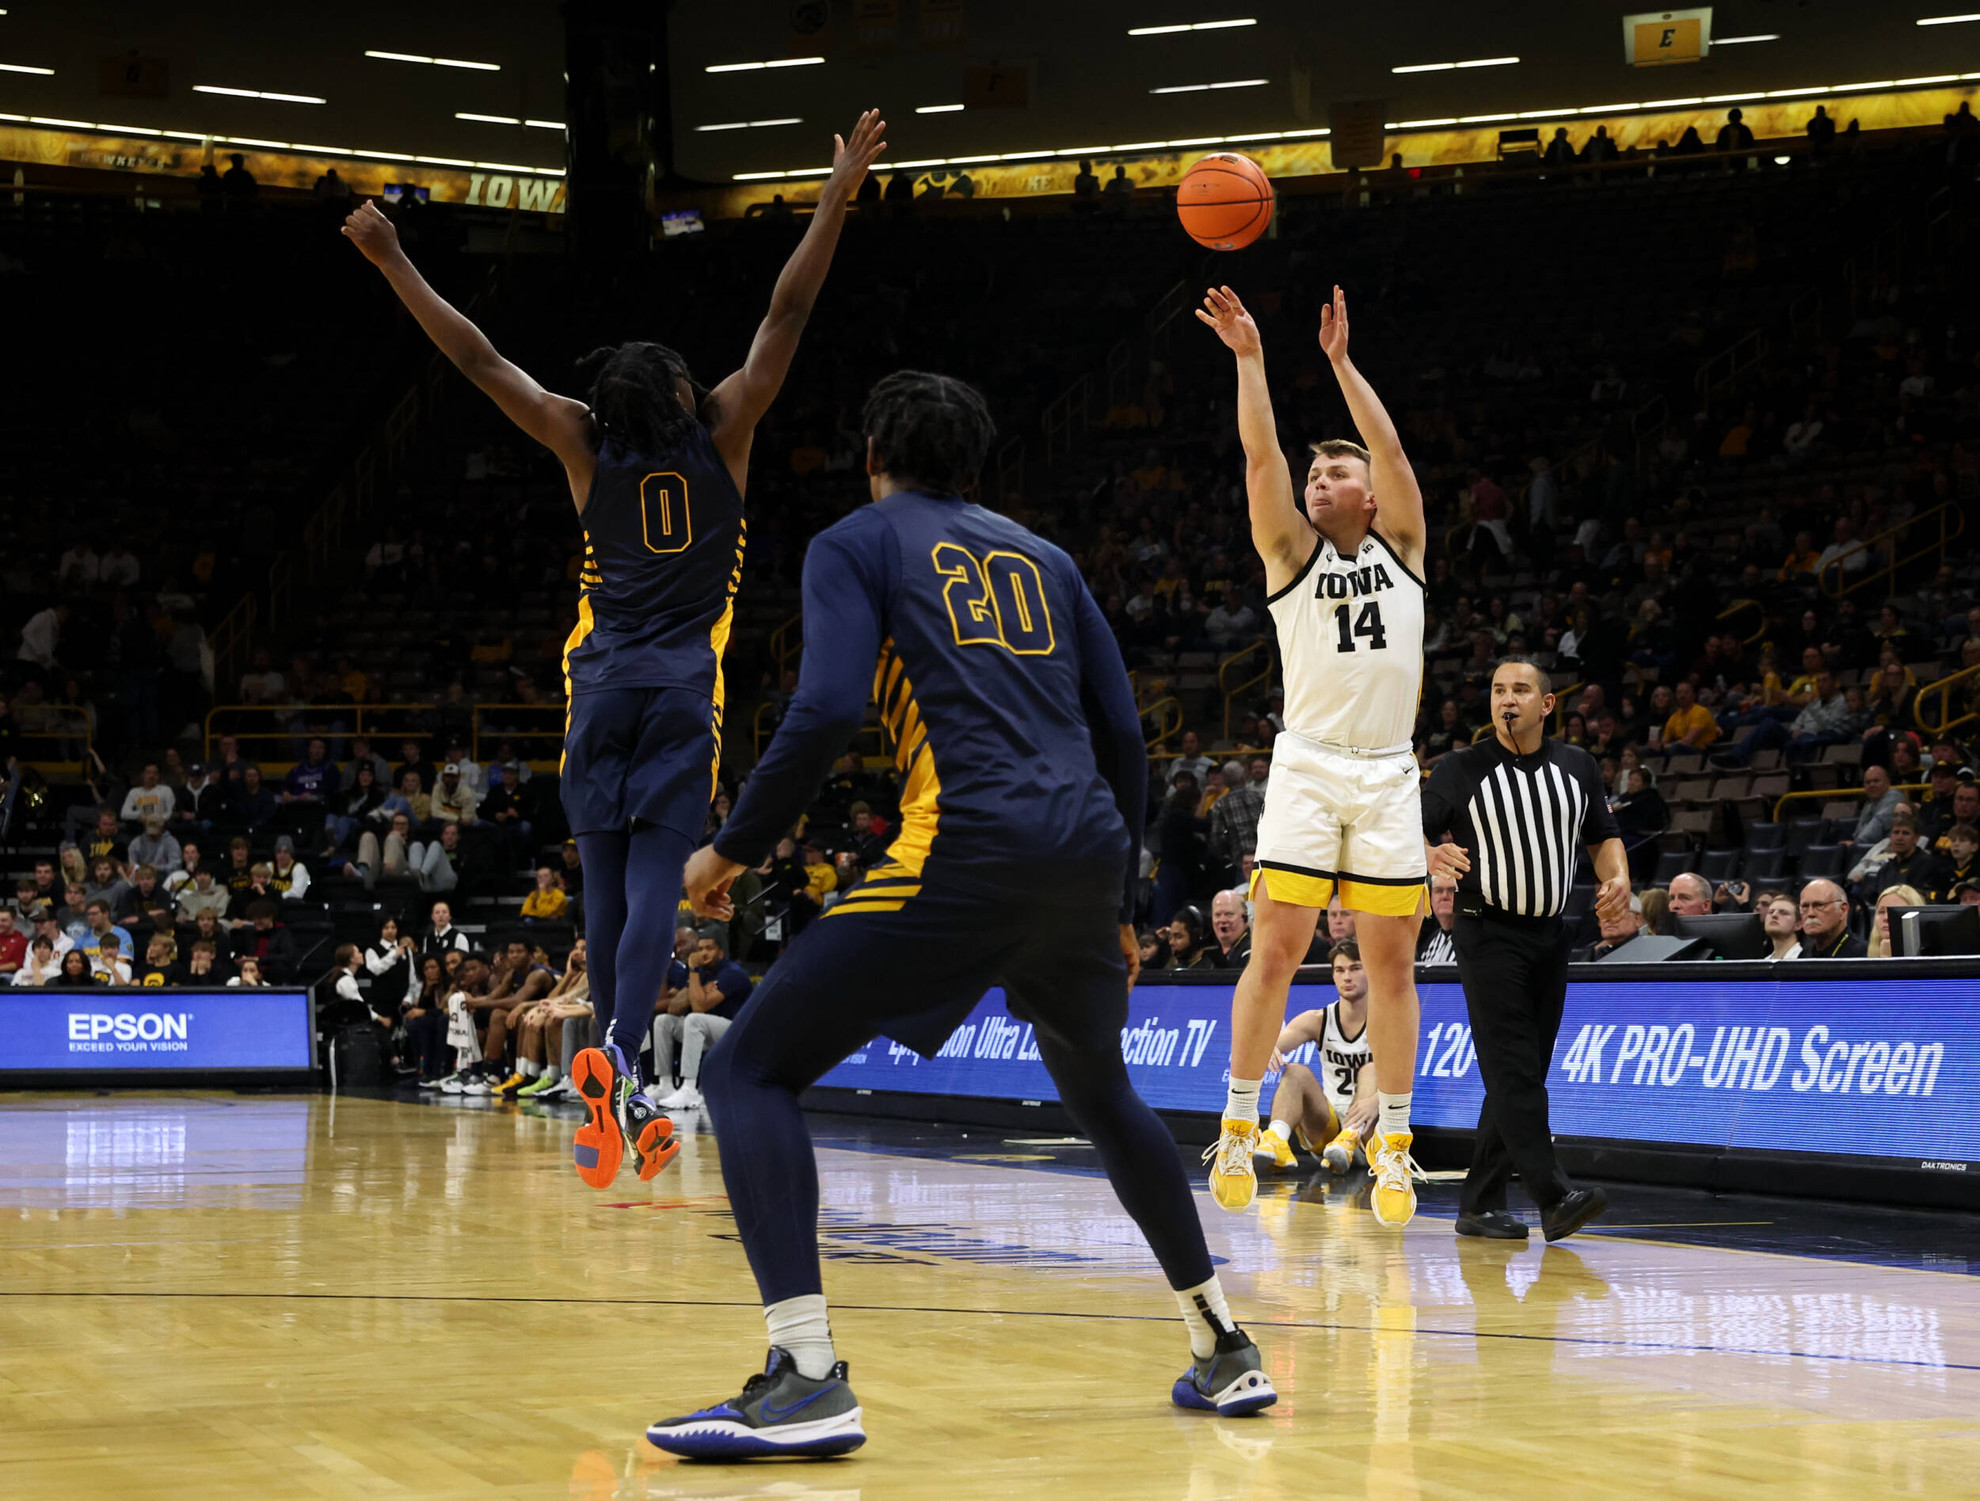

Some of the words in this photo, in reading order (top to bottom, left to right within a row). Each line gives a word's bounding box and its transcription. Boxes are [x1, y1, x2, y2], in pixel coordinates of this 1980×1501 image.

[1658, 28, 1676, 48] E
[640, 471, 692, 554] 0
[931, 541, 1056, 655] 20
[1315, 563, 1394, 600] IOWA
[1334, 601, 1387, 653] 14
[68, 1012, 188, 1041] EPSON
[69, 1042, 114, 1052] EXCEED
[116, 1042, 147, 1052] YOUR
[150, 1042, 188, 1051] VISION
[974, 1016, 1020, 1060] Ultra
[1178, 1019, 1218, 1068] TV
[1562, 1024, 1616, 1083] 4K
[1610, 1023, 1790, 1090] PRO-UHD
[1791, 1025, 1944, 1096] Screen
[1921, 1161, 1967, 1171] DAKTRONICS
